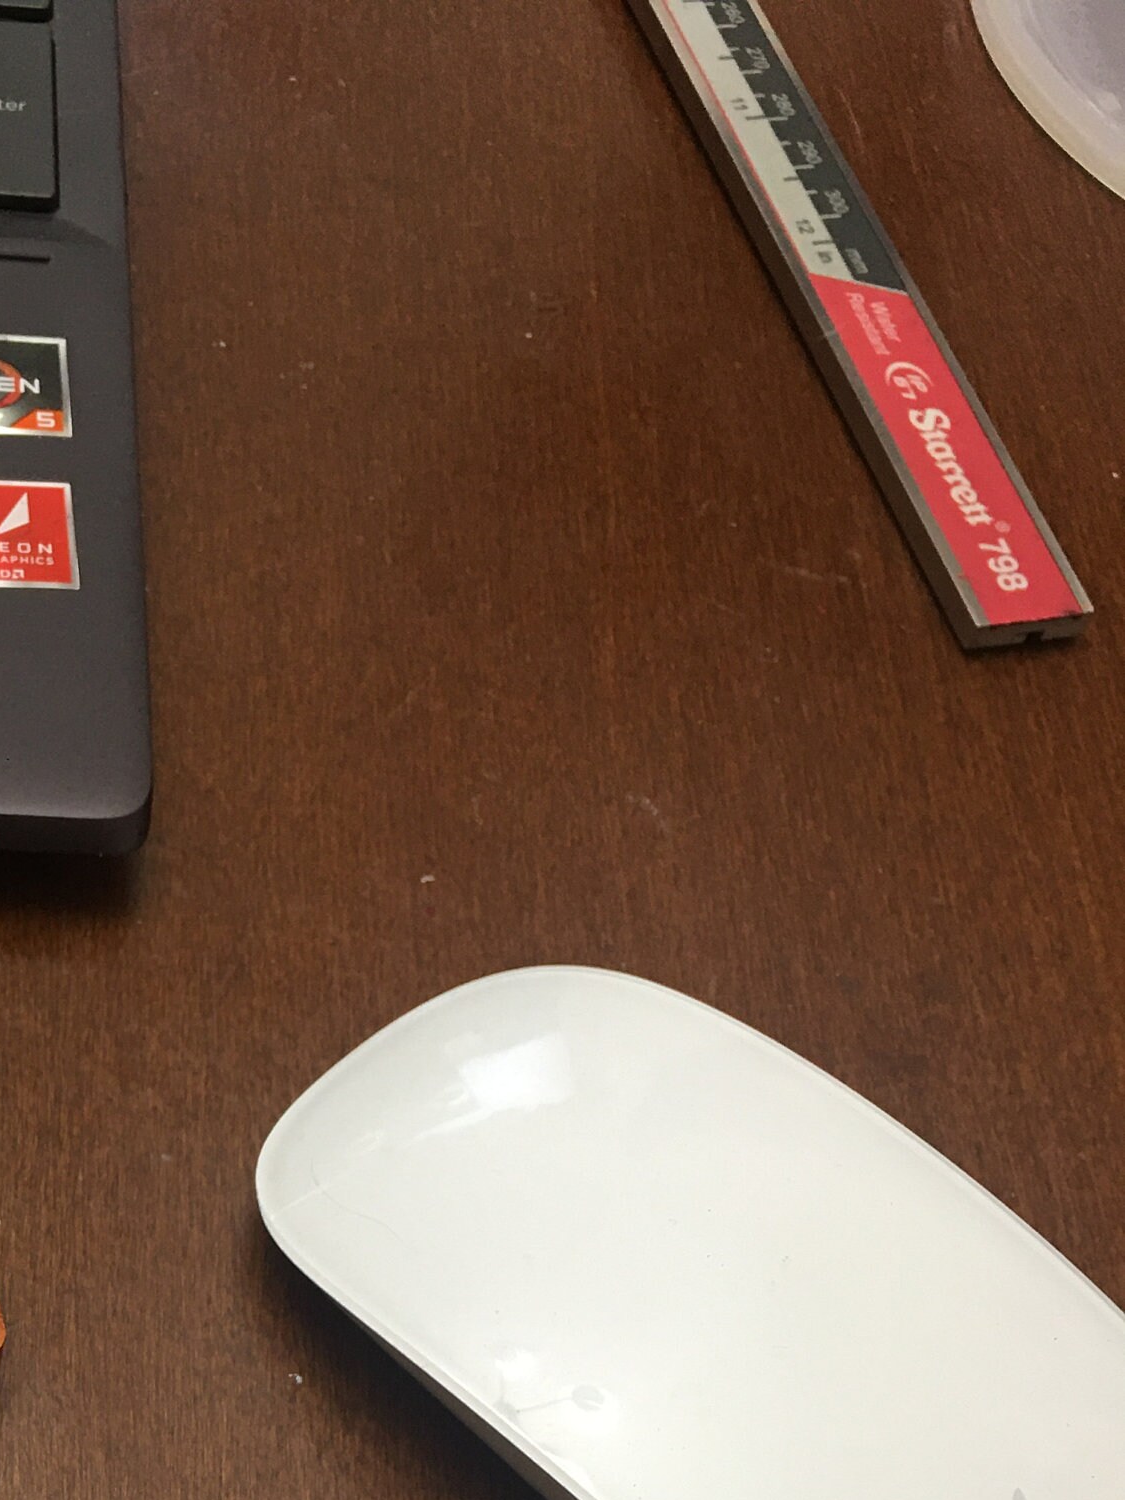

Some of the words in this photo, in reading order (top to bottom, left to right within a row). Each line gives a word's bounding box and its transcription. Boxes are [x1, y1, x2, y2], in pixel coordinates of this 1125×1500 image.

[744, 47, 770, 70] 270
[36, 410, 56, 429] 5
[908, 406, 994, 526] Starrett
[978, 537, 1029, 592] 798
